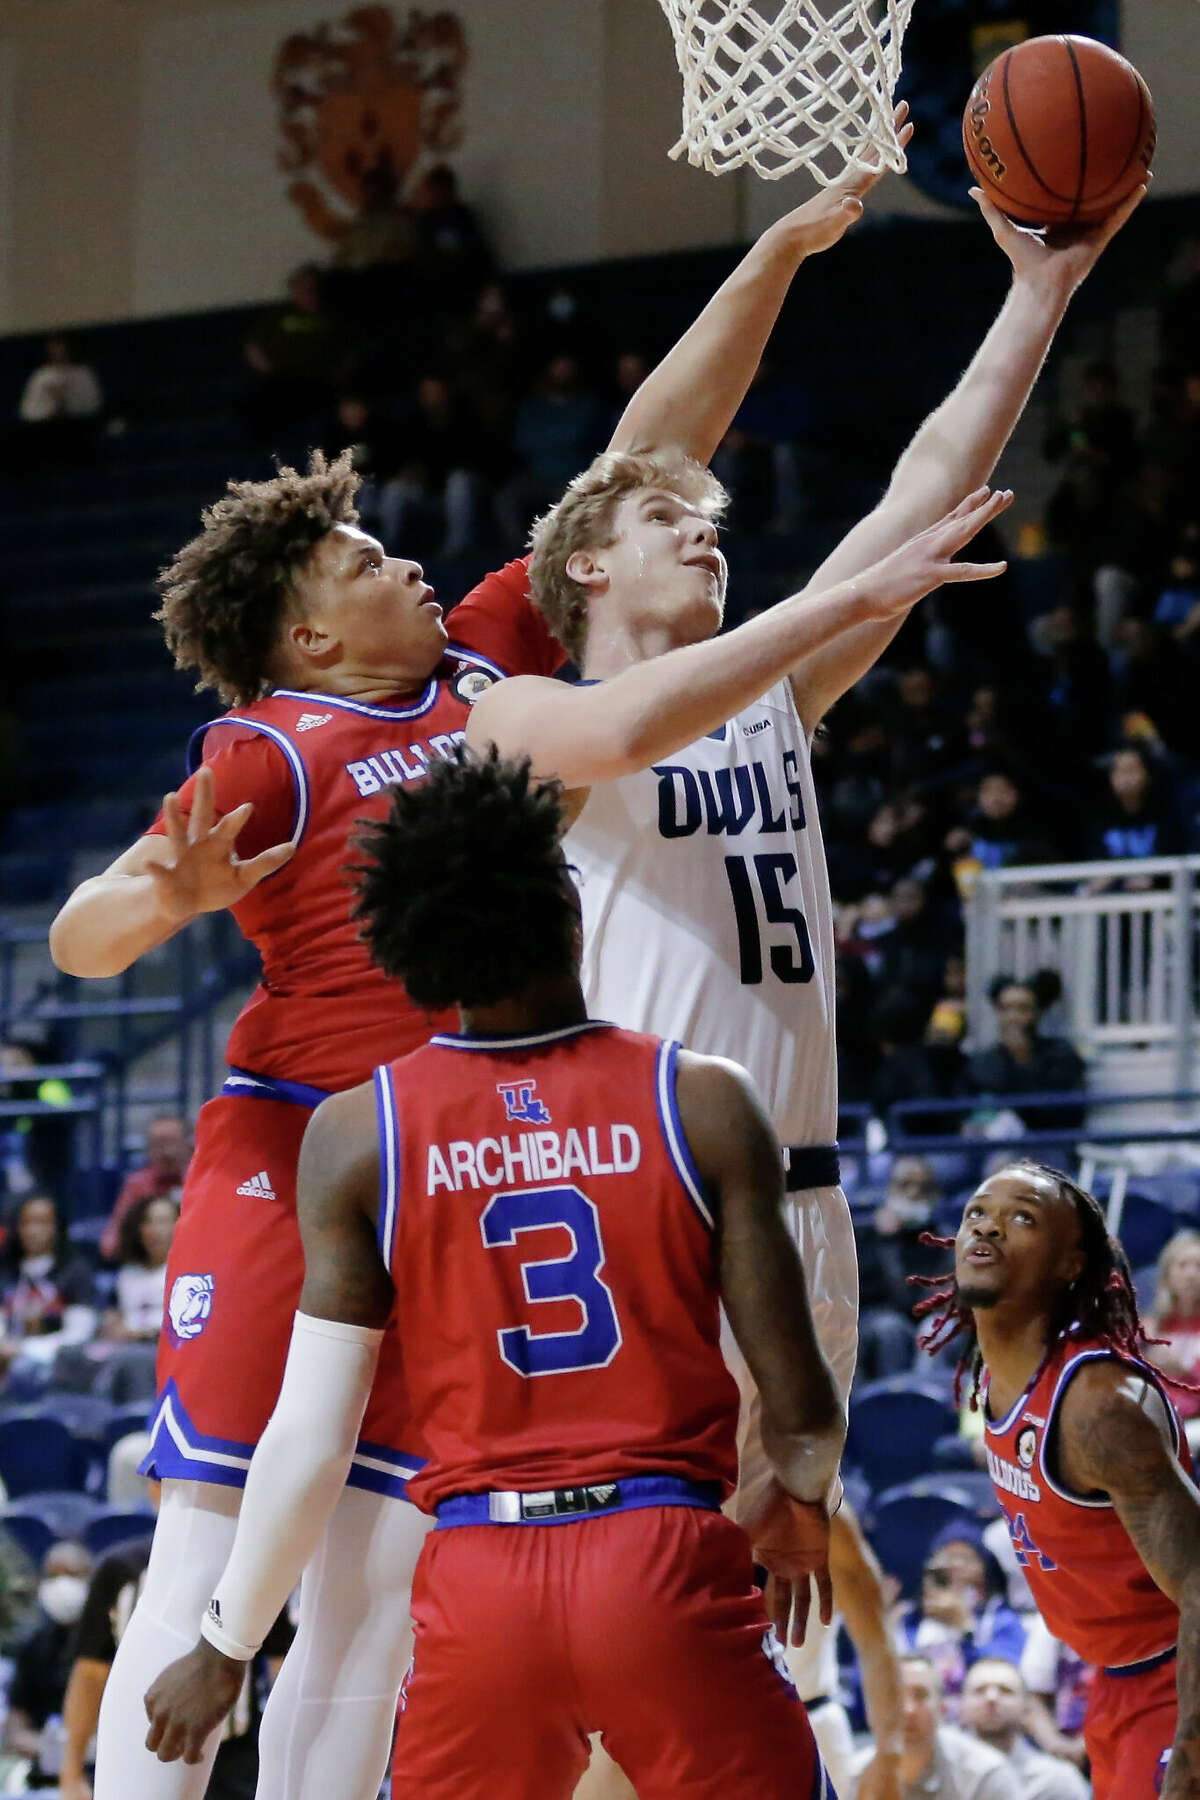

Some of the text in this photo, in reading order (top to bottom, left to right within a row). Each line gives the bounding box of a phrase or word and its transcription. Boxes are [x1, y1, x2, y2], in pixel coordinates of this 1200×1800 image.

[970, 71, 1007, 180] ilson
[296, 713, 333, 732] adidas
[651, 751, 806, 838] OWLS
[725, 853, 815, 984] 15
[236, 1186, 277, 1200] adidas
[427, 1123, 641, 1197] ARCHIBALD
[479, 1184, 623, 1377] 3
